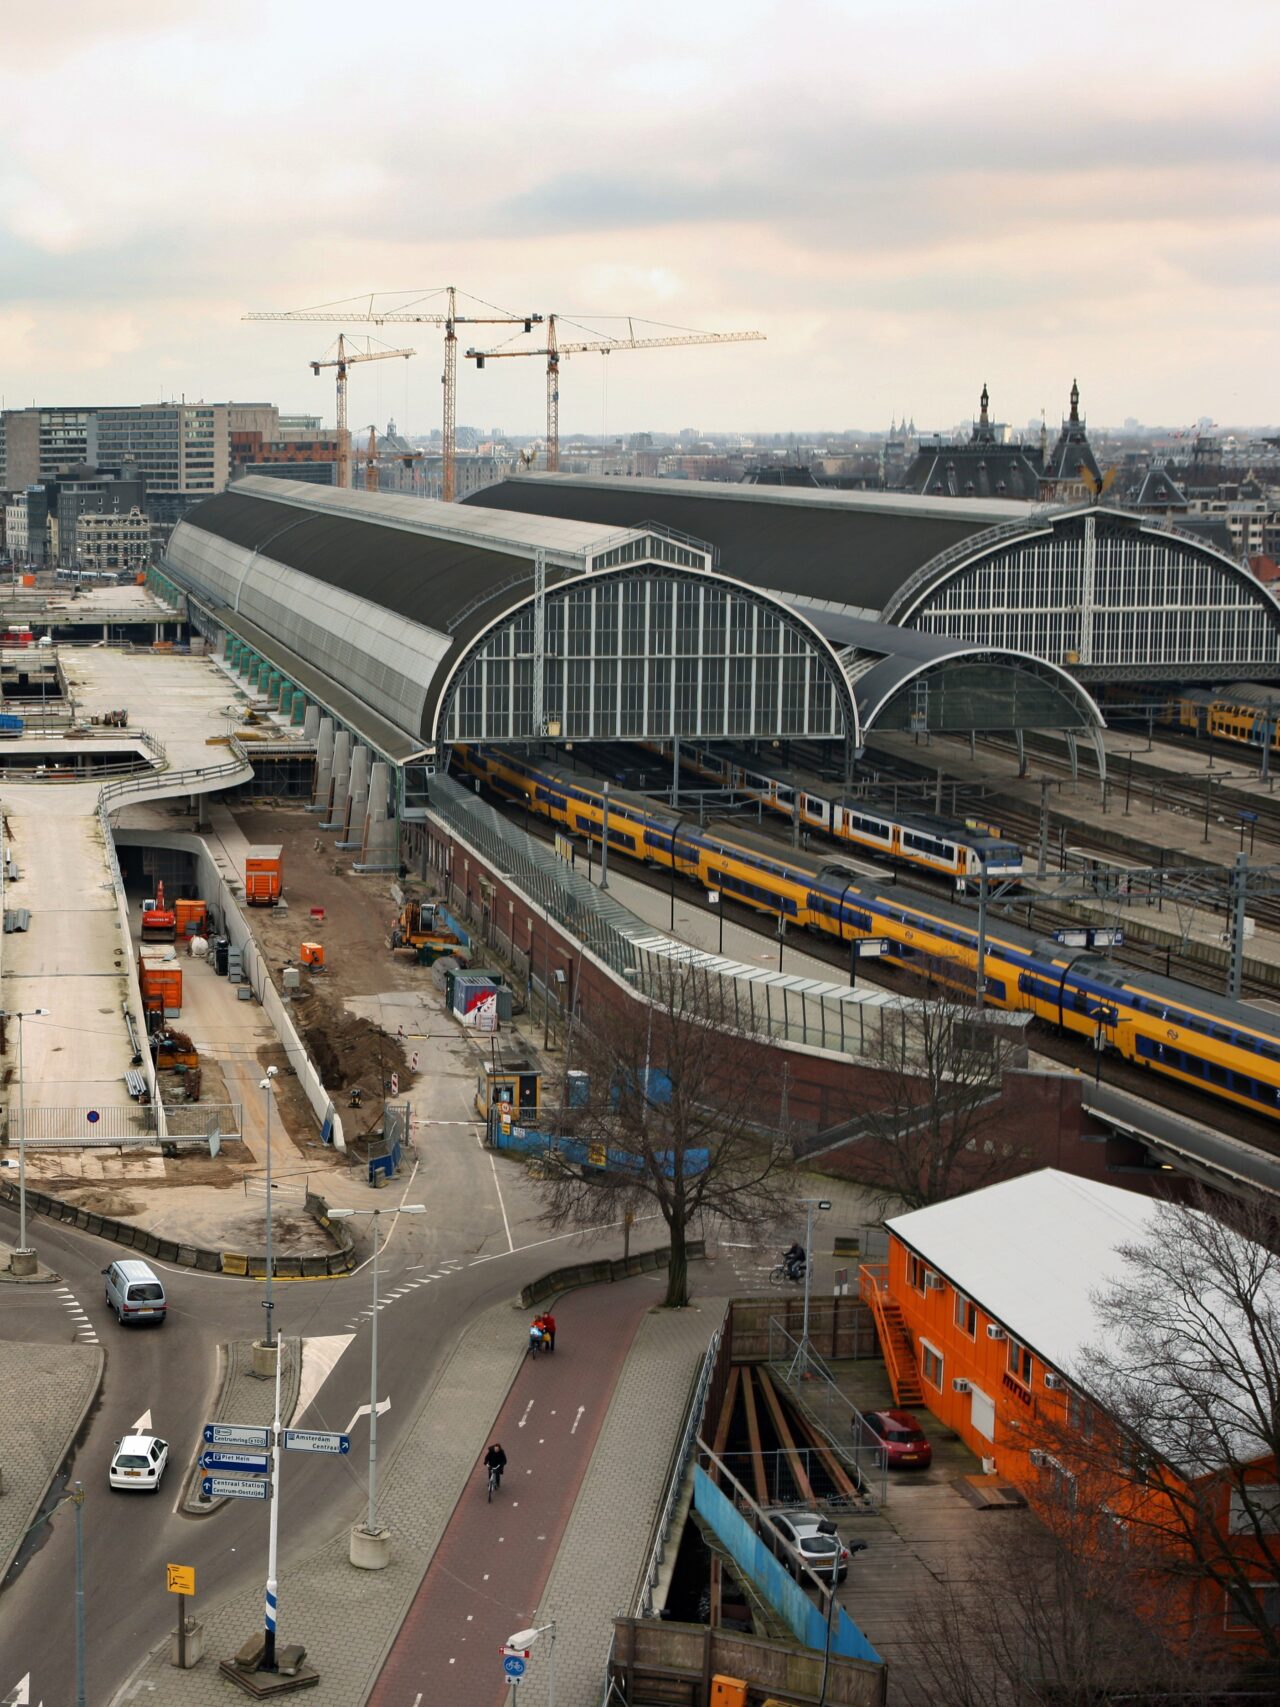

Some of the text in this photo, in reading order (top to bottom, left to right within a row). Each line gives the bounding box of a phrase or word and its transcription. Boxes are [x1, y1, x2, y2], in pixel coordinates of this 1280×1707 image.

[214, 1435, 248, 1444] Centrumring
[295, 1434, 331, 1442] Amsterdam
[312, 1443, 340, 1451] Centraal
[213, 1479, 265, 1489] Centraal Station
[213, 1487, 264, 1496] Centrum-Oostzijde
